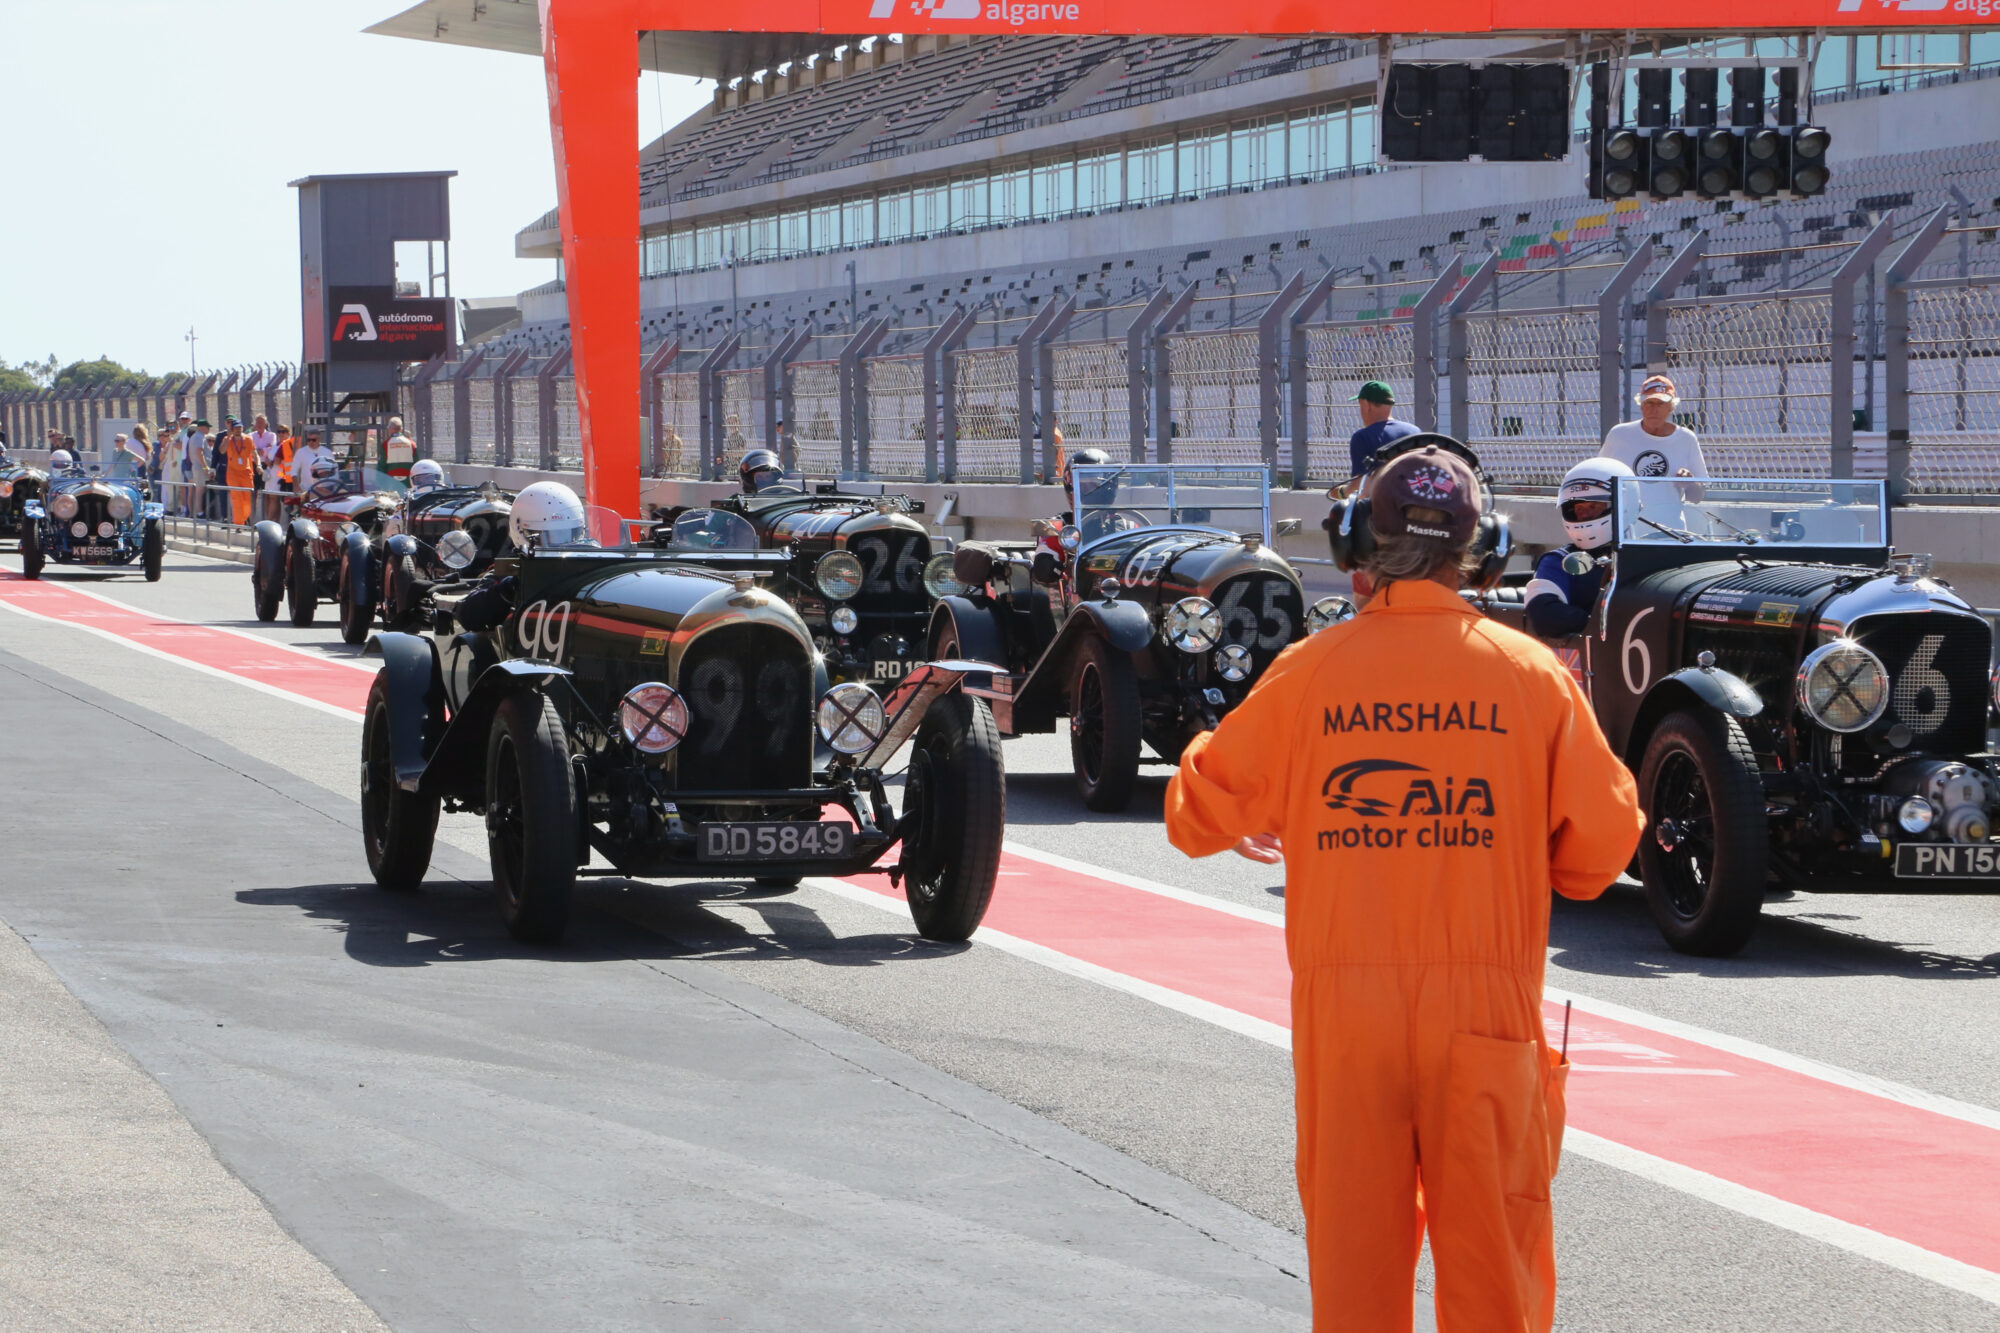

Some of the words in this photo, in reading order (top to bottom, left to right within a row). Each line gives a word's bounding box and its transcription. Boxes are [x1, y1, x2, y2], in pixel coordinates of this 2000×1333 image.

[986, 0, 1080, 26] algarve
[378, 322, 444, 331] internacional
[379, 313, 433, 323] autódromo
[379, 331, 417, 343] algarve
[1407, 524, 1450, 538] Masters
[858, 536, 921, 593] 26
[1218, 580, 1292, 650] 65
[1621, 606, 1656, 695] 6
[874, 660, 901, 679] RD
[1894, 634, 1951, 734] 6
[690, 656, 799, 756] 99
[1324, 700, 1508, 736] MARSHALL
[1317, 823, 1408, 850] motor
[1416, 819, 1494, 848] clube
[1915, 847, 1956, 873] PN
